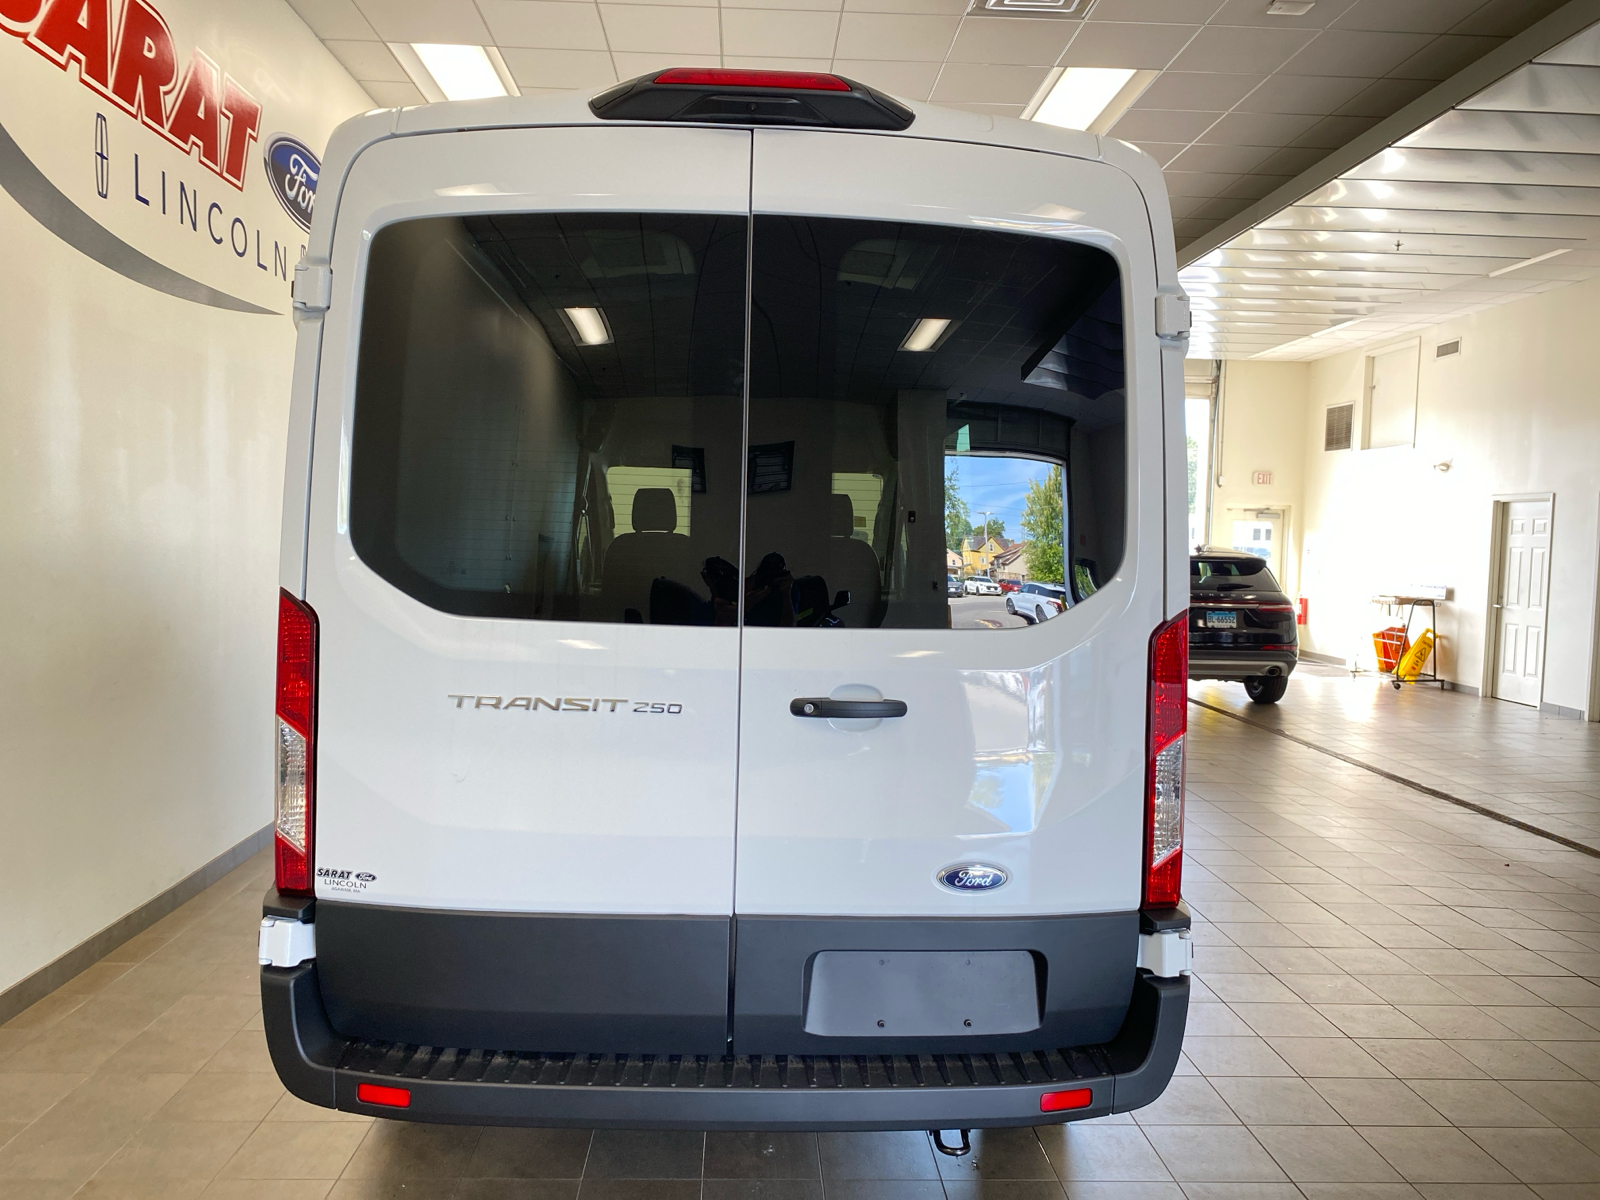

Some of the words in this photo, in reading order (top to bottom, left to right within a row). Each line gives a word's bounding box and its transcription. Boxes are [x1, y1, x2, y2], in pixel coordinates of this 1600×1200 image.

[0, 0, 263, 192] ARAT
[134, 153, 287, 282] LINCOLN
[1257, 472, 1272, 485] EXIT
[447, 694, 629, 712] TRANSIT
[632, 702, 683, 714] 250
[317, 867, 352, 879] SARAT
[954, 870, 994, 886] Ford
[324, 879, 366, 889] LINCOLN
